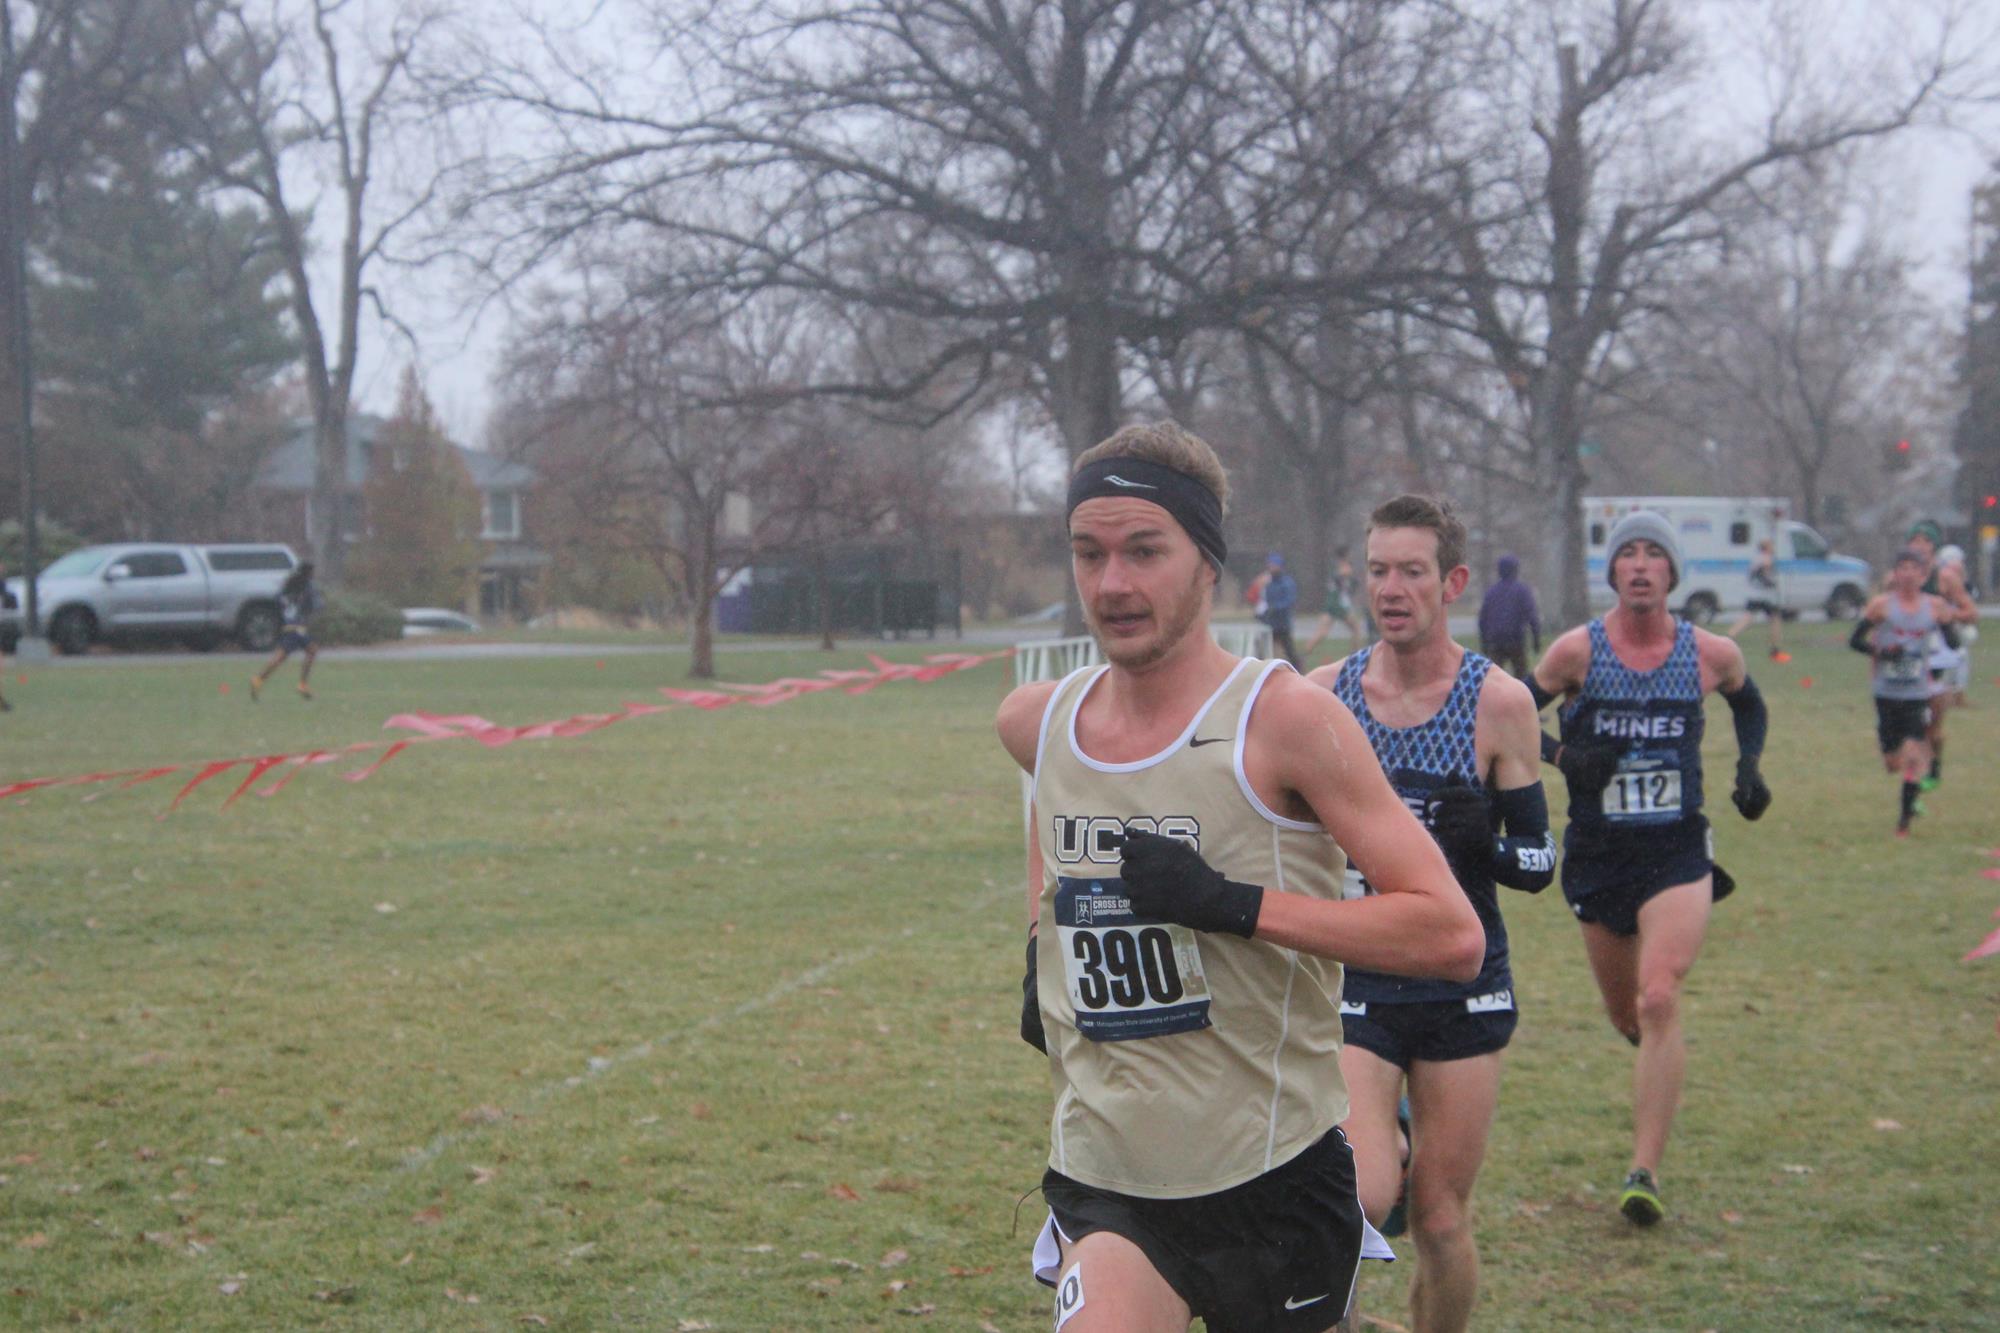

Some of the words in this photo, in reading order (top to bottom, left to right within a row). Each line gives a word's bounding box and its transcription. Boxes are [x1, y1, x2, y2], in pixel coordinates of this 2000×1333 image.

[1594, 709, 1686, 738] MINES
[1616, 774, 1668, 811] 112
[1093, 900, 1117, 909] CROSS
[1072, 927, 1184, 1010] 390
